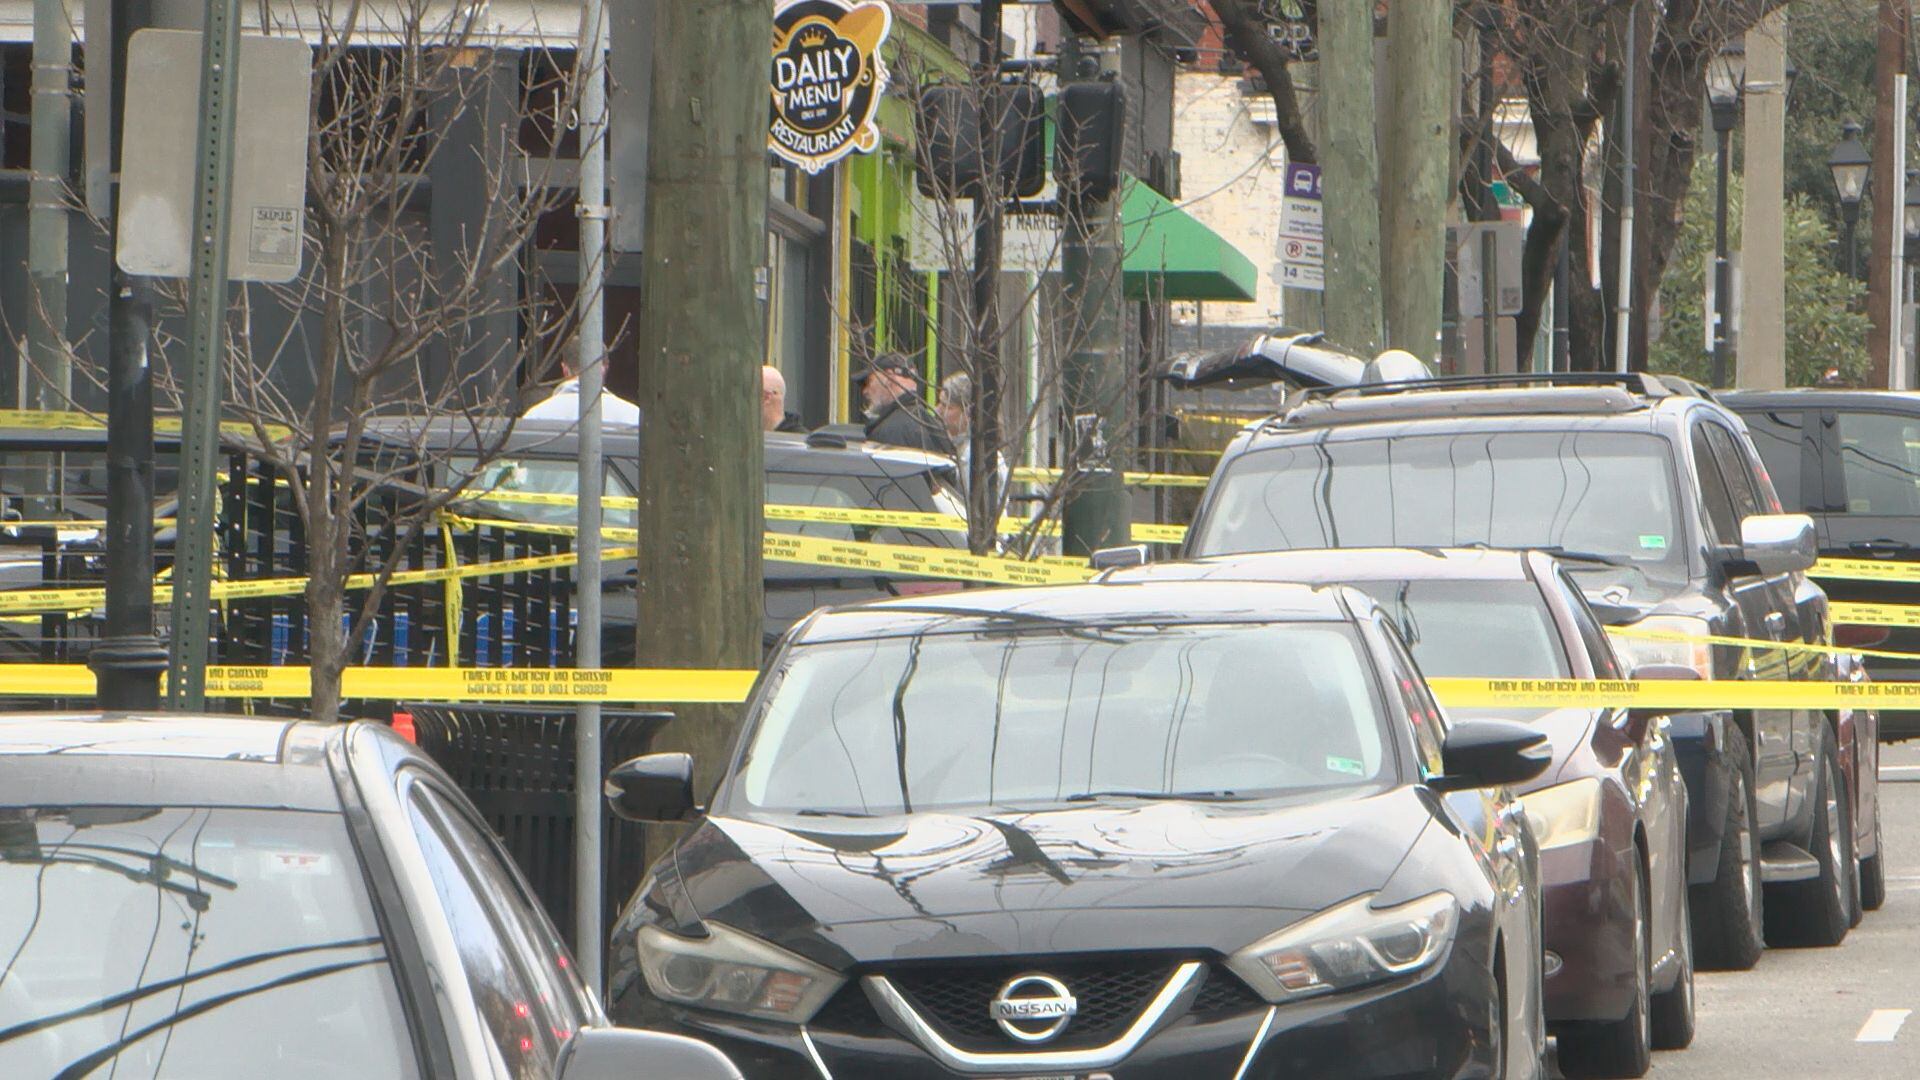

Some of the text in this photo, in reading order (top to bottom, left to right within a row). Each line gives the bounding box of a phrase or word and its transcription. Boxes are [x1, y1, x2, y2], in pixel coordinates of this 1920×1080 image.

[776, 45, 853, 90] DAILY
[789, 81, 841, 110] MENU
[770, 114, 856, 154] RESTAURANT
[1284, 266, 1297, 278] 14
[1000, 1002, 1067, 1015] NISSAN
